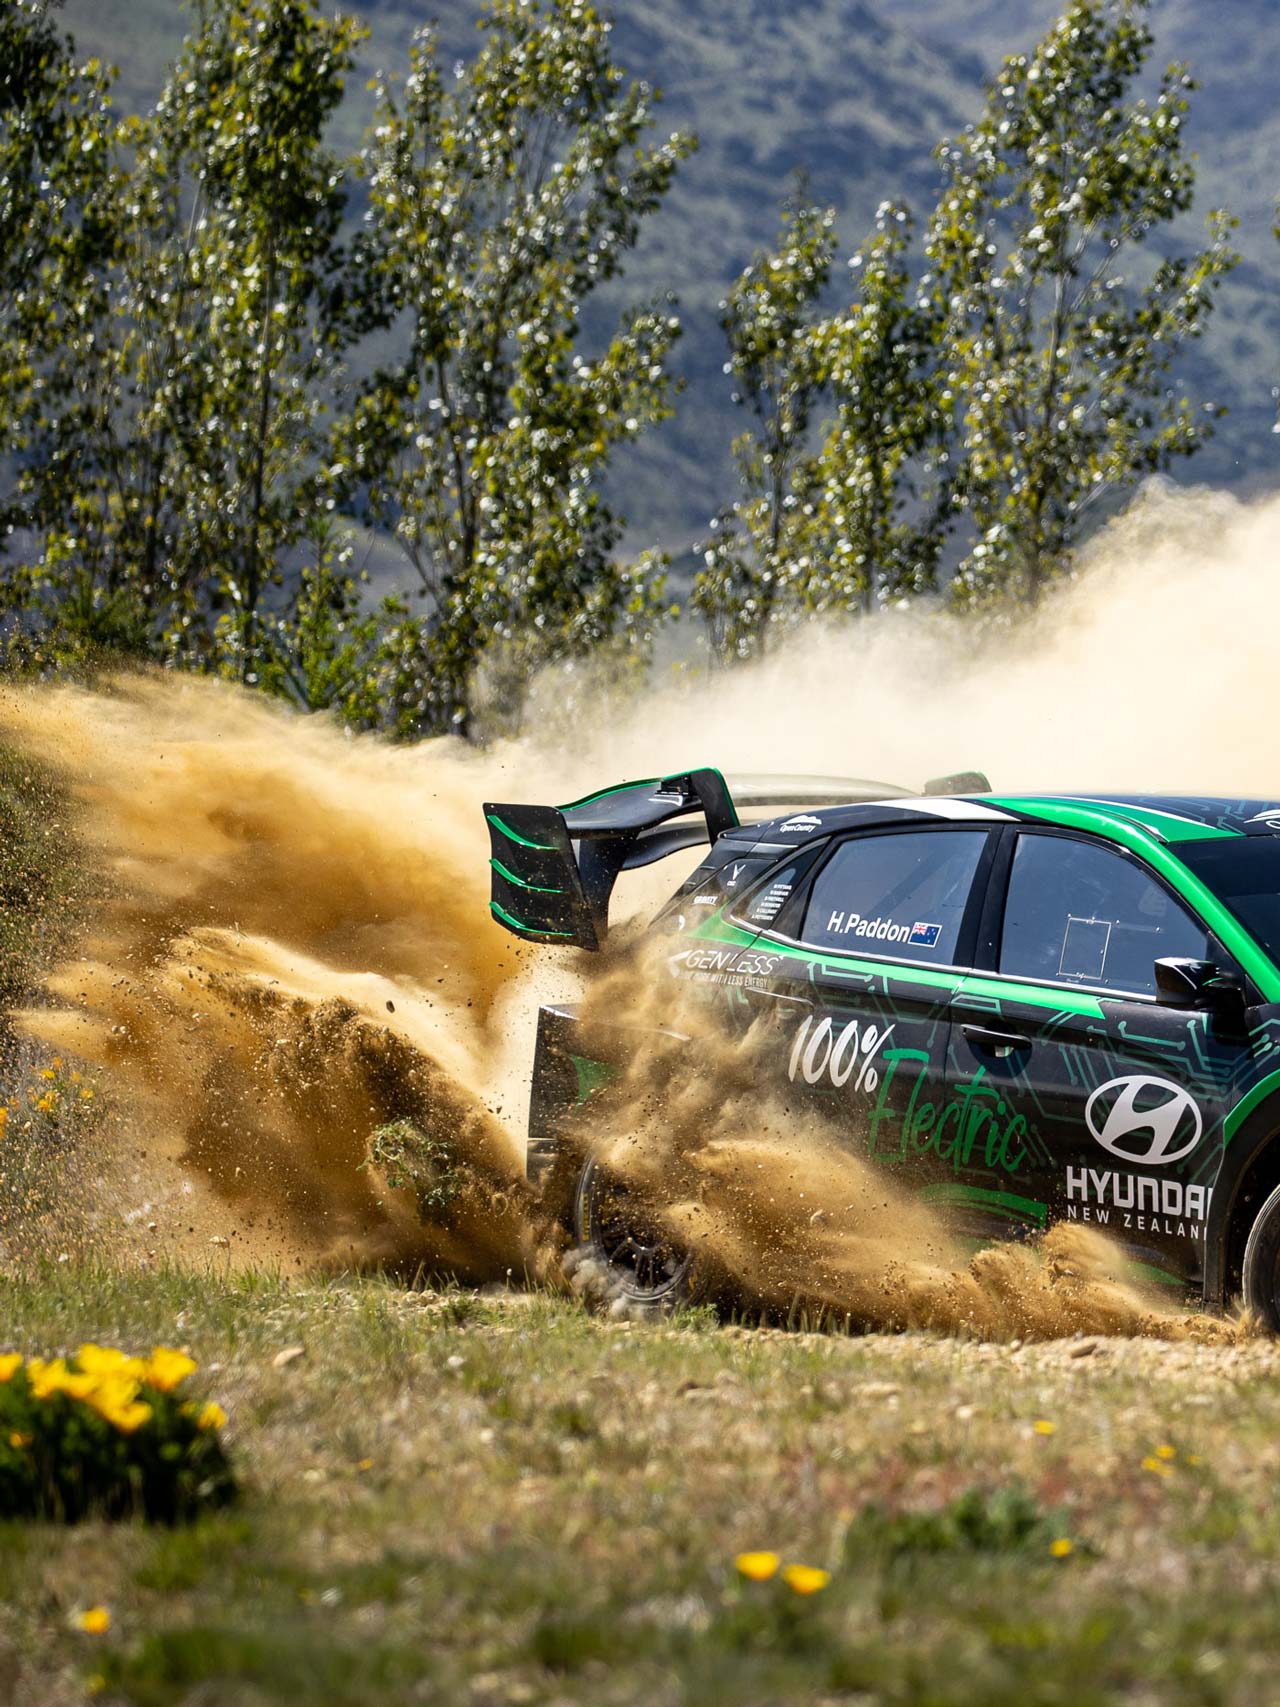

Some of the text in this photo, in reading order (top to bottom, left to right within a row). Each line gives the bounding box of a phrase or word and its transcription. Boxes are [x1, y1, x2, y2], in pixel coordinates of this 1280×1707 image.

[826, 911, 910, 943] H.Paddon
[788, 1015, 896, 1093] 100%
[867, 1048, 1028, 1175] Electric
[1067, 1204, 1110, 1224] NEW
